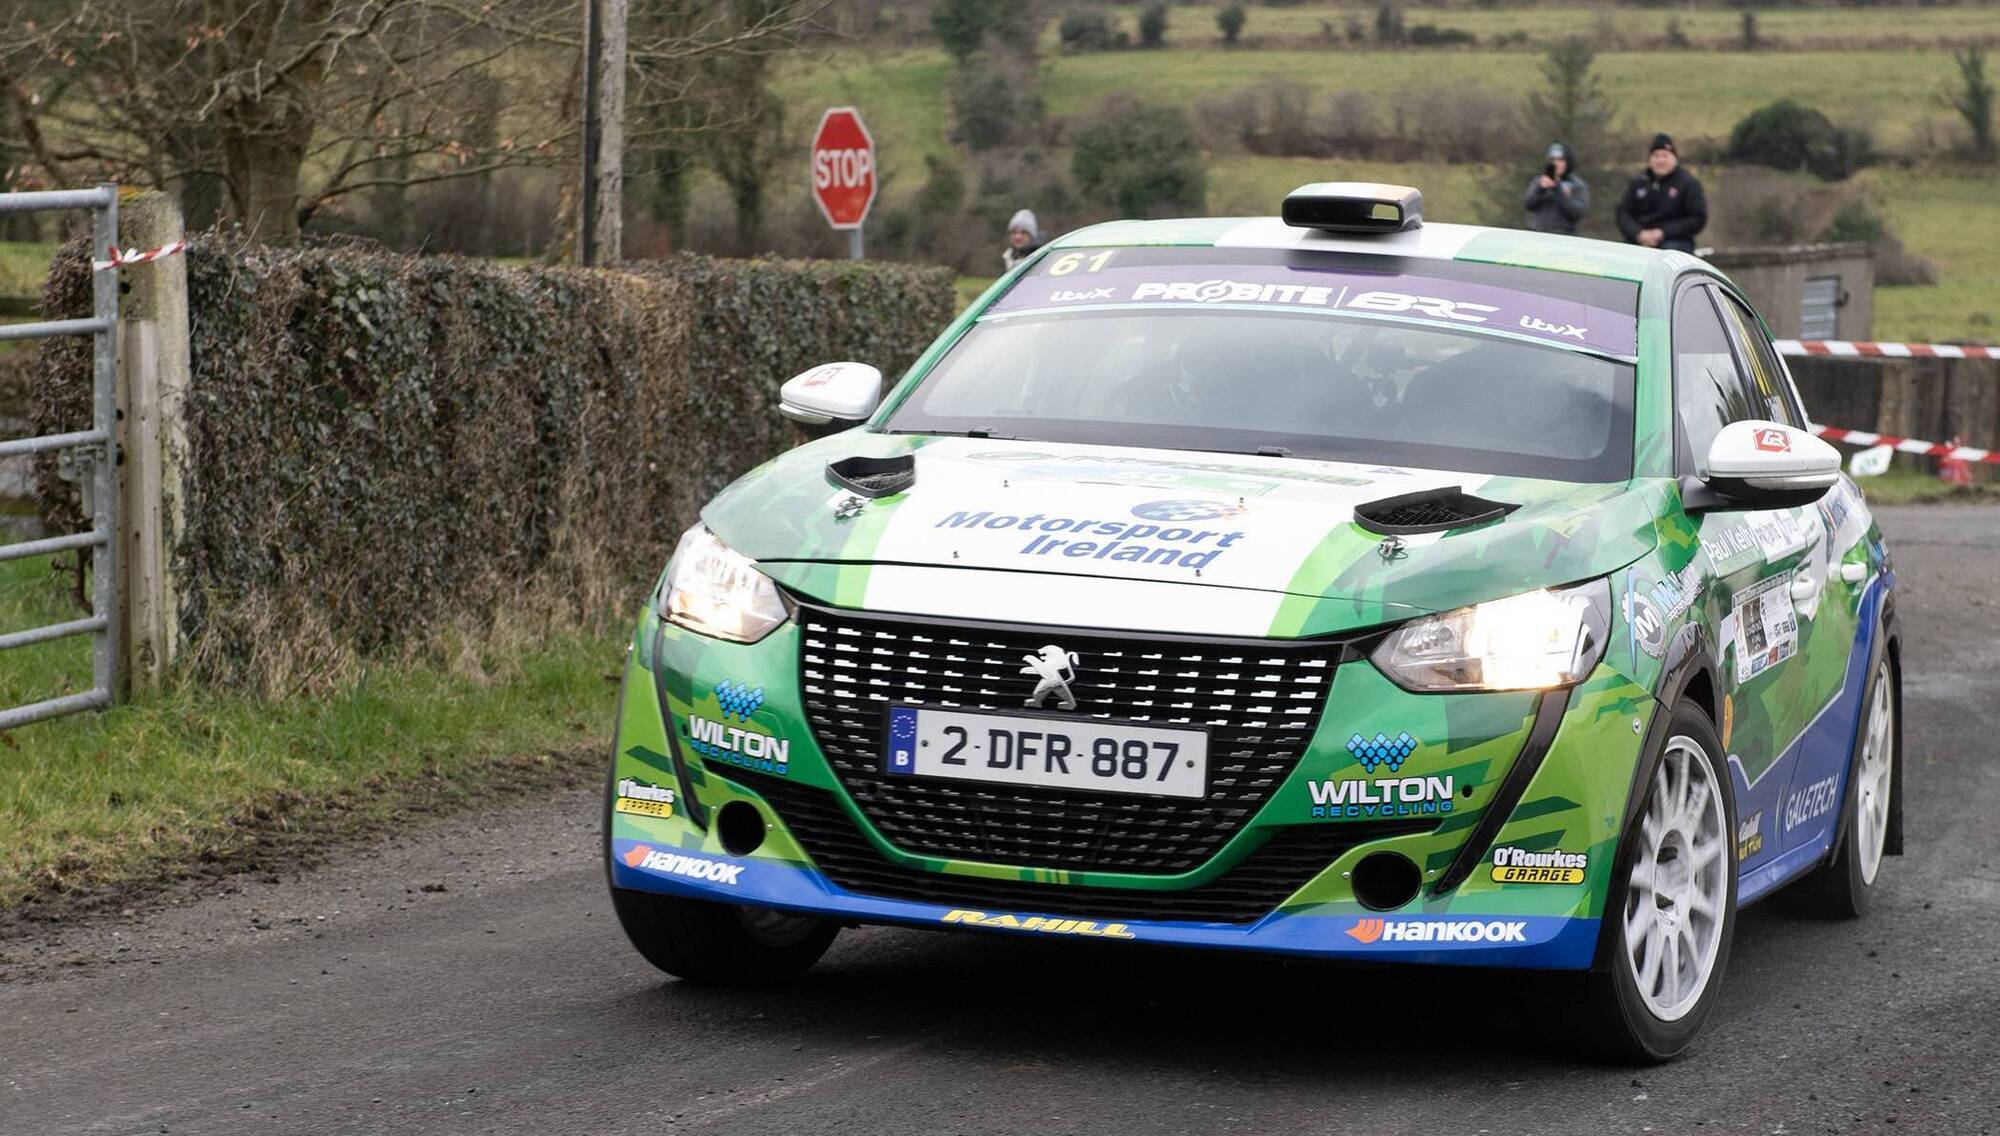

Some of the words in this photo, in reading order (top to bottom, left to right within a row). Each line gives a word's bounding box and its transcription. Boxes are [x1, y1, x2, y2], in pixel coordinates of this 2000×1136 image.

[815, 148, 871, 189] STOP
[1049, 250, 1113, 276] 61
[1131, 280, 1333, 304] PROBITE
[1346, 291, 1500, 322] BRC
[934, 511, 1245, 548] Motorsport
[1019, 530, 1223, 569] Ireland
[688, 714, 789, 763] WILTON
[941, 726, 1180, 782] 2-DFR-887
[690, 740, 788, 774] RECYCLING
[895, 751, 909, 766] B
[1308, 776, 1453, 805] WILTON
[1786, 774, 1839, 832] GALETECH
[1311, 801, 1454, 818] RECYCLING
[1493, 848, 1587, 869] O'Rourkes
[1503, 867, 1572, 882] GARAGE
[941, 909, 1137, 940] RAHILL
